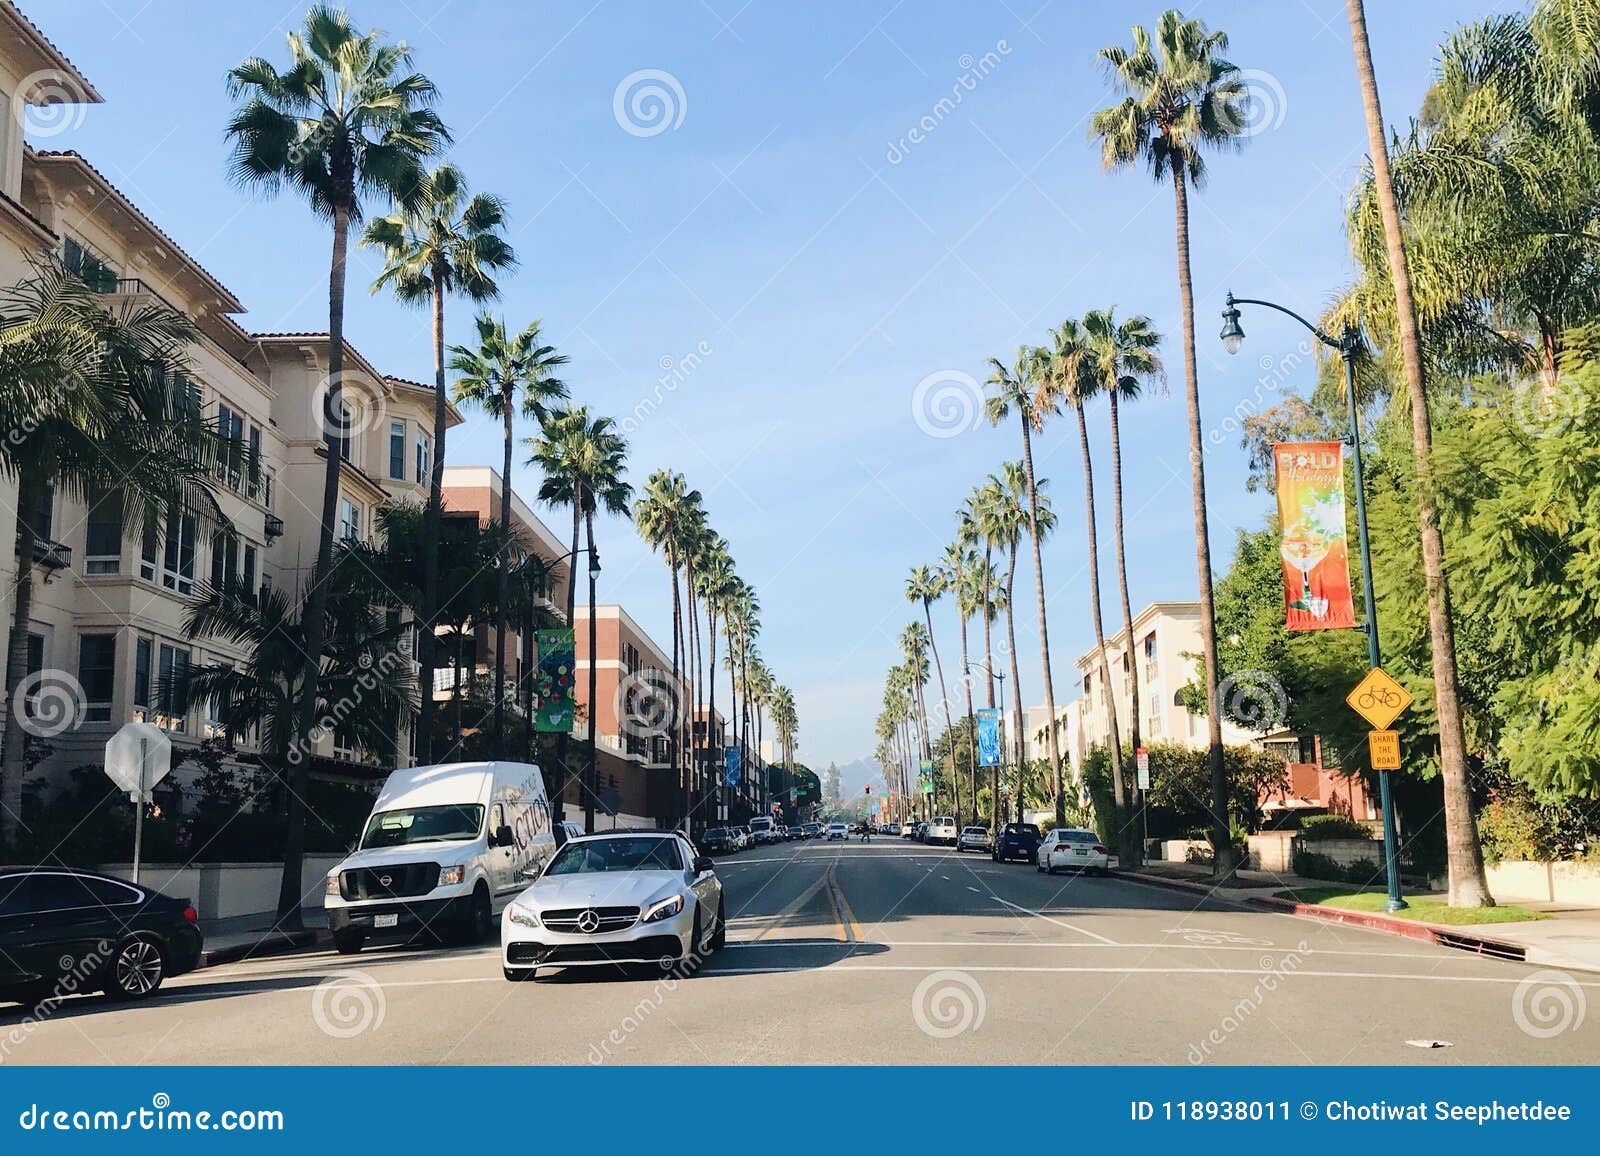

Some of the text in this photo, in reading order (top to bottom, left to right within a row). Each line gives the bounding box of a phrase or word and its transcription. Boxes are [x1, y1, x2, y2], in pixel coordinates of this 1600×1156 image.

[1372, 735, 1395, 743] SHARE
[1378, 745, 1392, 753] THE
[1376, 756, 1396, 764] ROAD
